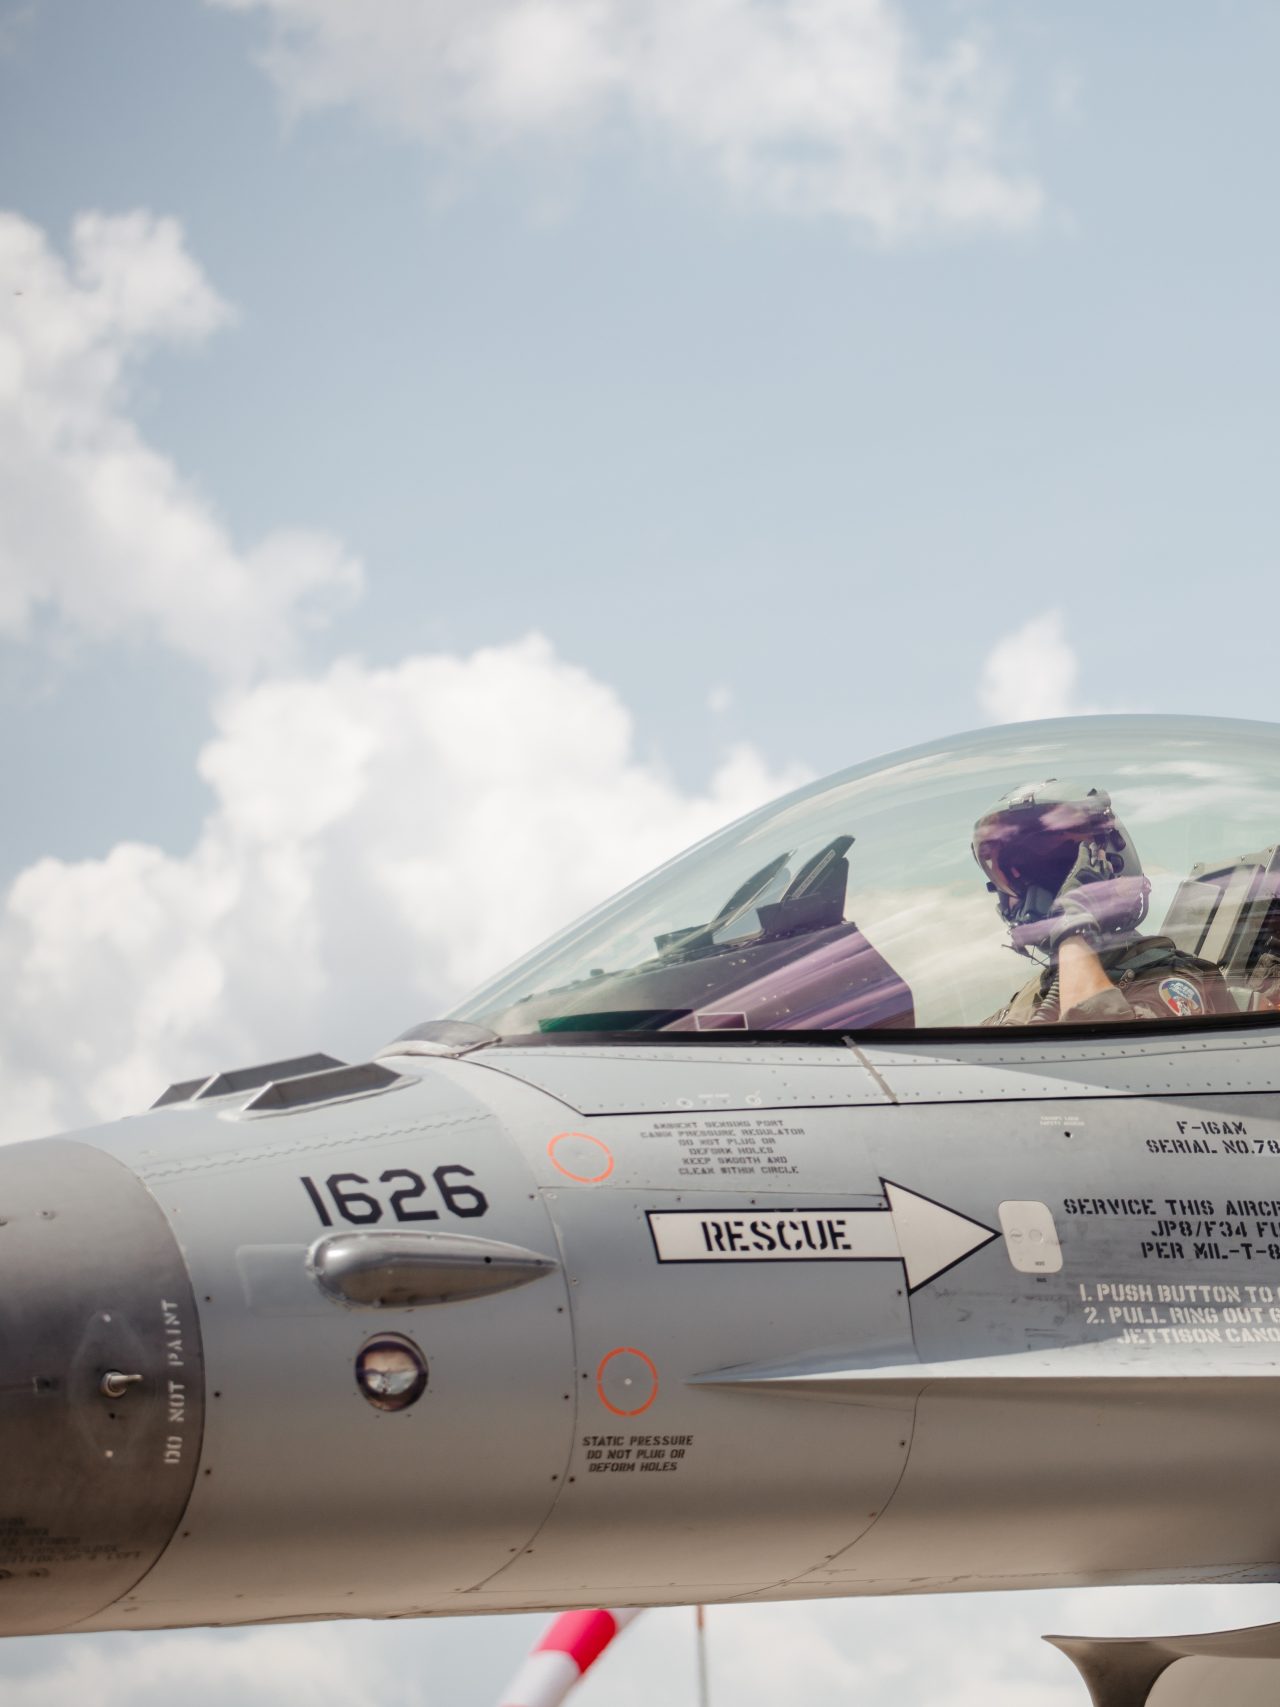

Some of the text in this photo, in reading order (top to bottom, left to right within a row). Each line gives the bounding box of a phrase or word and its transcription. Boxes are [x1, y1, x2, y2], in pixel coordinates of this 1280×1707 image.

[1176, 1120, 1248, 1135] F-16AM
[1146, 1139, 1218, 1154] SERIAL
[300, 1164, 489, 1226] 1626
[1063, 1198, 1157, 1215] SERVICE
[1165, 1199, 1215, 1216] THIS
[701, 1219, 852, 1251] RESCUE
[1151, 1220, 1248, 1238] JP8/F34
[1141, 1242, 1184, 1259] PER
[1079, 1283, 1093, 1302] 1.
[1096, 1283, 1154, 1302] PUSH
[1157, 1284, 1242, 1303] BUTTON
[1244, 1286, 1273, 1303] TO
[1084, 1306, 1105, 1324] 2.
[1108, 1306, 1167, 1324] PULL
[1169, 1307, 1219, 1324] RING
[1222, 1307, 1263, 1324] OUT
[1117, 1328, 1222, 1344] JETTISON
[161, 1299, 185, 1464] DO NOT PAINT
[582, 1435, 694, 1446] STATIC PRESSURE
[586, 1449, 685, 1459] DO NOT PLUG OR
[588, 1461, 677, 1472] DEFORM HOLES
